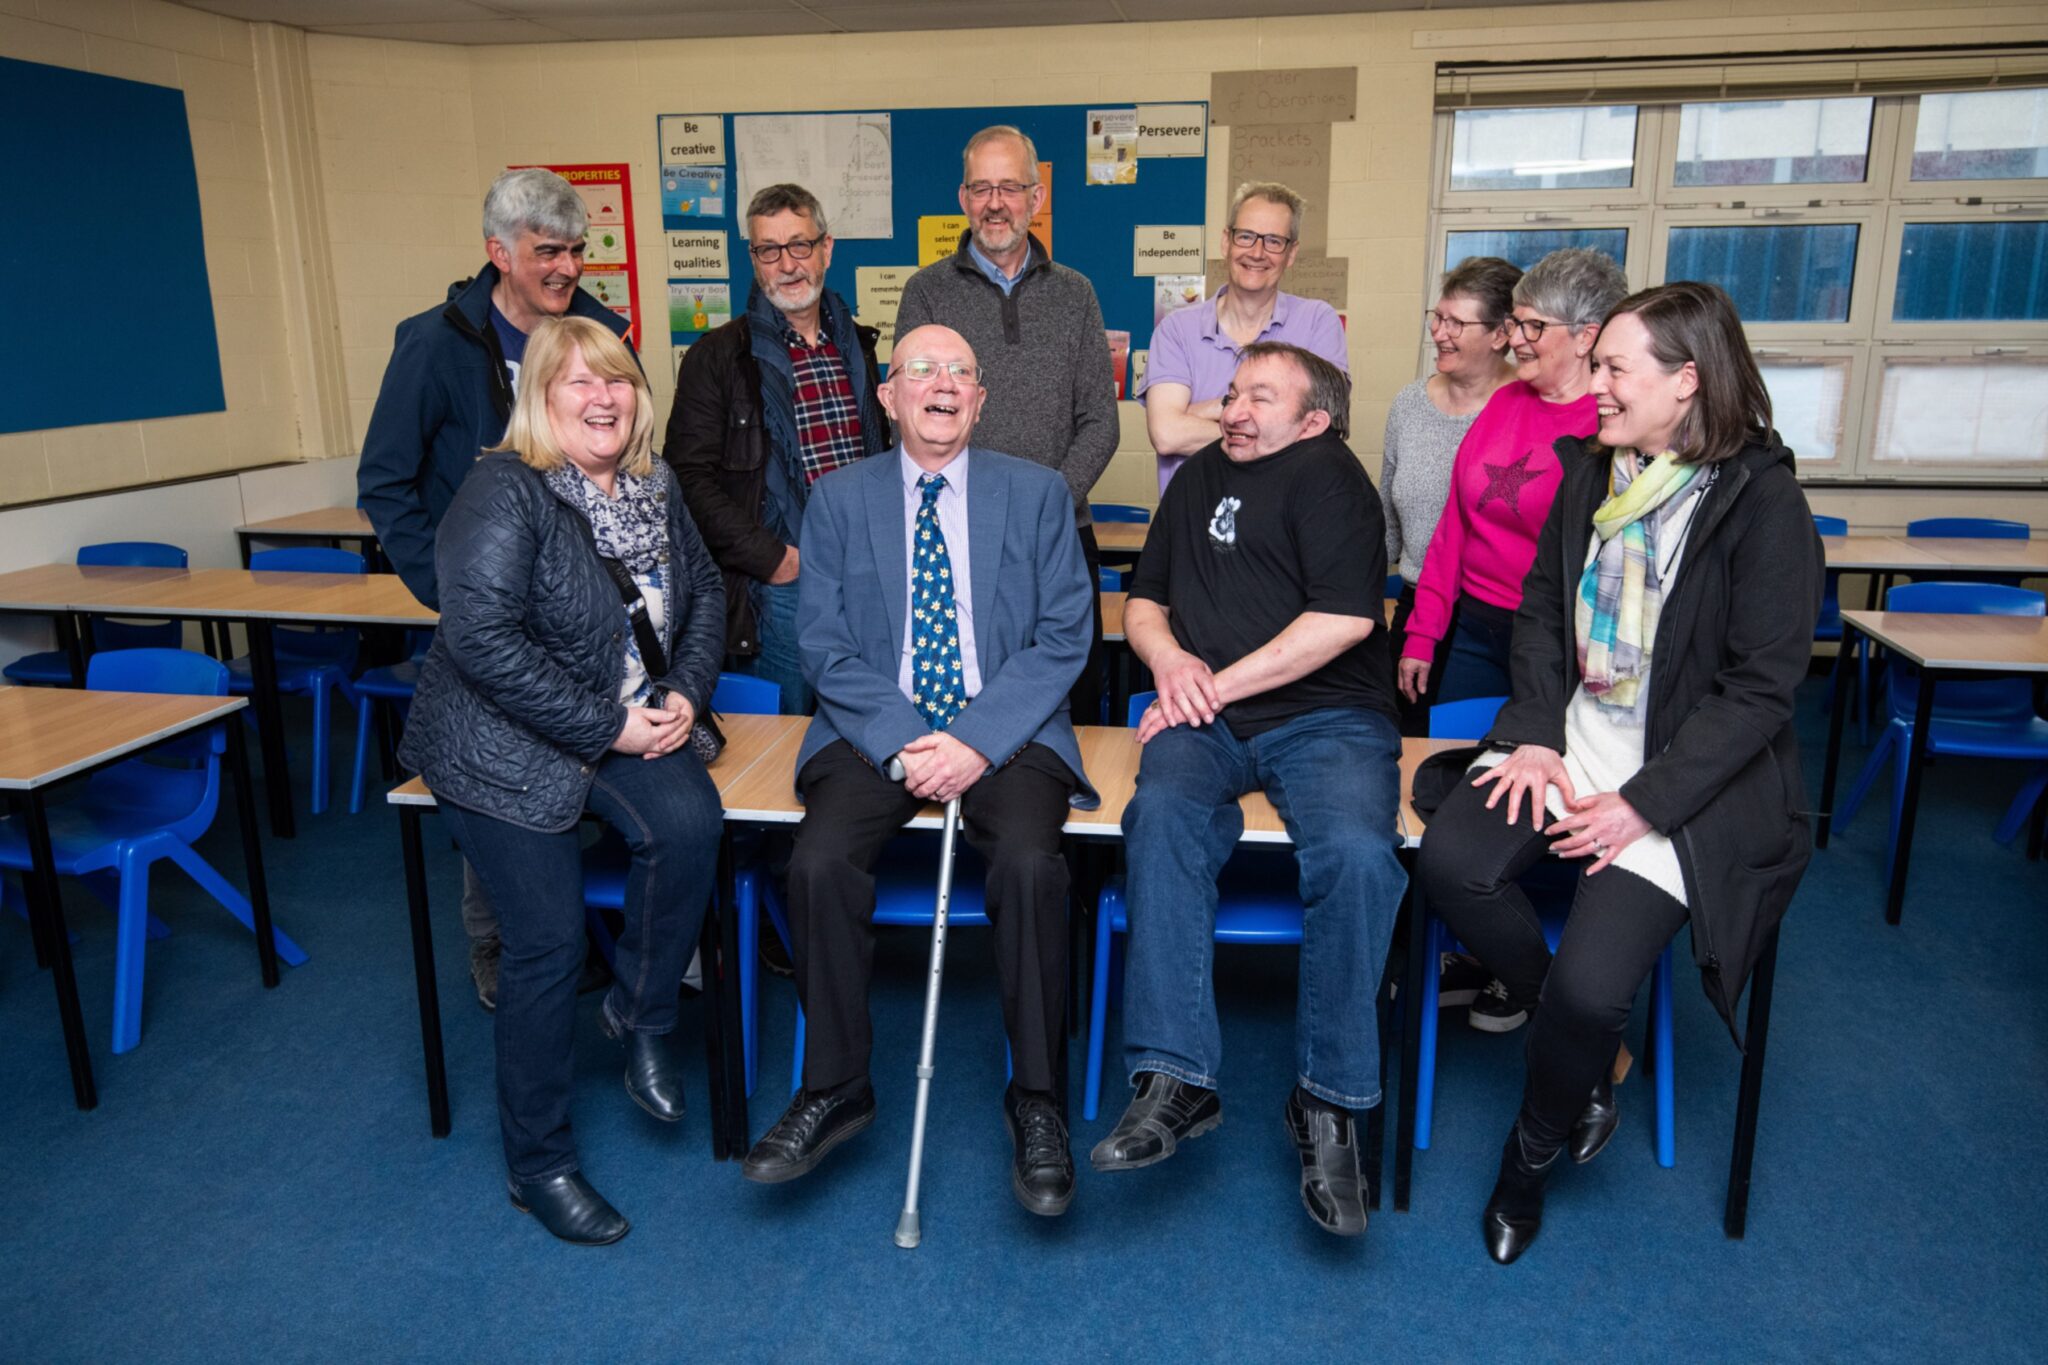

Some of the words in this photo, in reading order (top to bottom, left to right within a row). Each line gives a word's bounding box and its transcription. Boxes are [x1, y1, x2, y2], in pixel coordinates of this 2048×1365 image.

[1256, 90, 1347, 118] Operations
[1089, 112, 1135, 122] Persevere
[684, 122, 698, 133] Be
[1138, 125, 1201, 137] Persevere
[1233, 128, 1312, 150] Brackets
[670, 143, 716, 155] creative
[663, 168, 675, 177] Be
[678, 168, 722, 179] Creative
[935, 235, 955, 243] select
[1163, 231, 1176, 240] Be
[672, 237, 720, 250] Learning
[1138, 247, 1200, 259] independent
[673, 257, 722, 269] qualities
[670, 286, 683, 295] Try
[685, 286, 705, 294] Your
[708, 286, 727, 294] Best
[870, 285, 903, 293] remembe
[879, 299, 898, 307] many
[875, 320, 896, 328] differ
